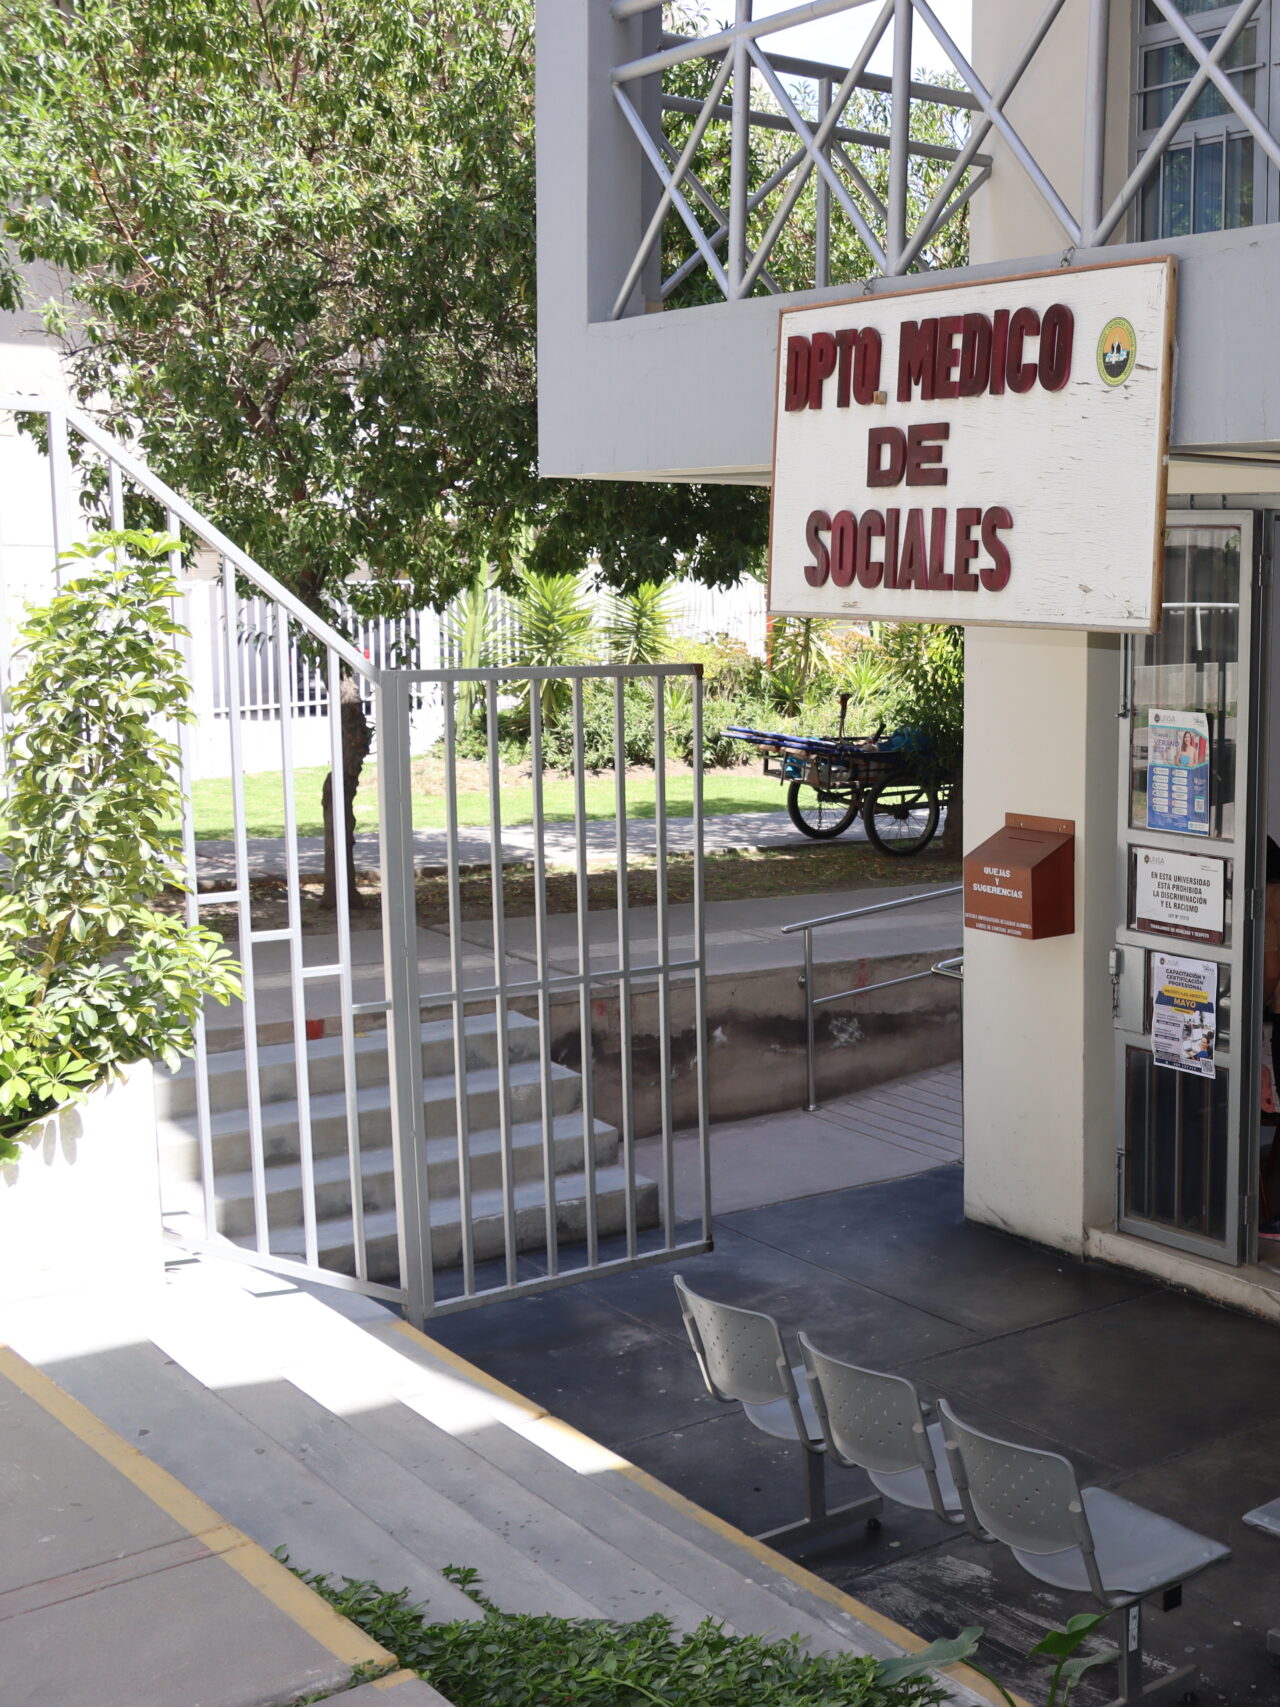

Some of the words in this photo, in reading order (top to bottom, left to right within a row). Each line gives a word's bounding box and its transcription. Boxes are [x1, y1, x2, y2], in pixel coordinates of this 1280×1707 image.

[896, 303, 1075, 403] MEDICO
[866, 422, 950, 488] DE
[803, 506, 1014, 592] SOCIALES
[983, 866, 1011, 878] QUEJAS
[994, 877, 1000, 886] Y
[1150, 871, 1158, 879] EN
[1159, 872, 1172, 882] ESTA
[1173, 874, 1211, 887] UNIVERSIDAD
[972, 882, 1023, 899] SUGERENCIAS
[1152, 889, 1160, 898] LA
[1171, 883, 1202, 895] PROHIBIDA
[1160, 899, 1165, 908] Y
[1165, 901, 1172, 909] EL
[1173, 901, 1199, 914] RACISMO
[1168, 980, 1203, 991] PROFESIONAL
[1173, 997, 1197, 1009] MAYO
